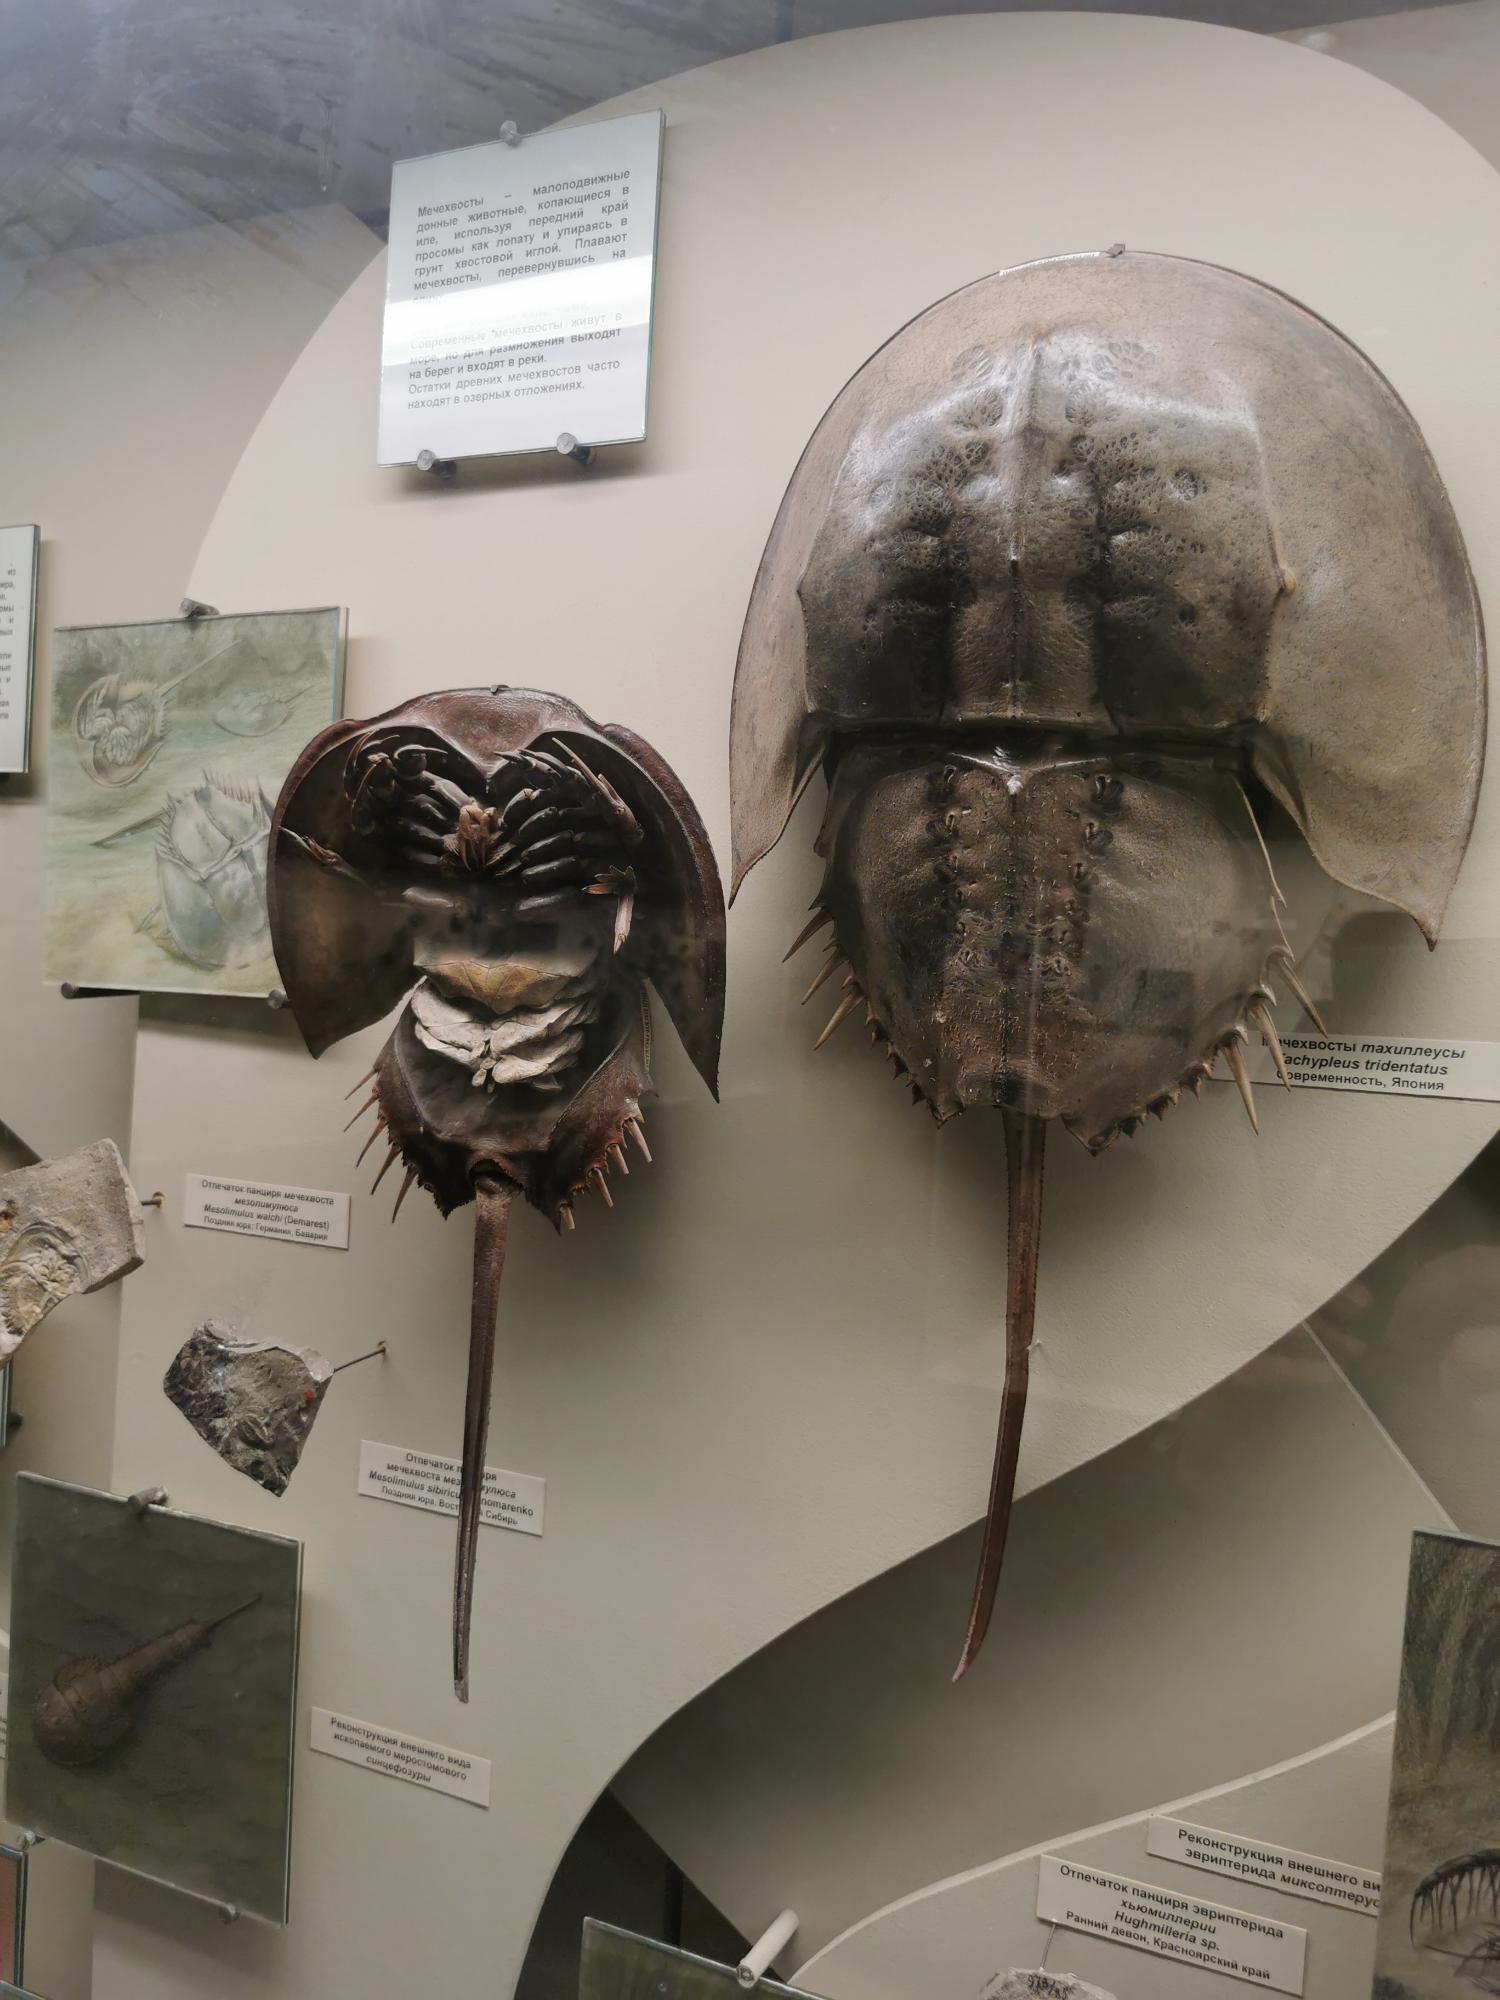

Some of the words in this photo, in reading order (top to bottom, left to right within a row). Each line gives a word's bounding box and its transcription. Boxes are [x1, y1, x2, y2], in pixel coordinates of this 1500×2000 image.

[418, 197, 484, 218] Мечехвосты
[533, 170, 631, 196] малоподвижные
[416, 217, 458, 234] донные
[468, 204, 527, 222] животные,
[538, 190, 611, 210] копающиеся
[623, 186, 629, 195] в
[416, 236, 439, 247] иле,
[454, 223, 512, 241] используя
[528, 209, 584, 227] передний
[601, 201, 629, 216] край
[415, 245, 465, 263] просомы
[471, 241, 489, 252] как
[496, 233, 535, 248] лопату
[543, 231, 550, 239] и
[557, 220, 612, 240] упираясь
[621, 217, 628, 226] в
[415, 264, 444, 277] грунт
[455, 251, 513, 271] хвостовой
[526, 244, 561, 258] иглой.
[575, 233, 628, 249] Плавают
[414, 272, 482, 291] мечехвосты,
[498, 256, 595, 279] перевернувшись
[612, 249, 626, 259] на
[489, 336, 564, 355] размножения
[571, 328, 622, 343] выходят
[409, 370, 422, 380] на
[425, 364, 453, 379] берег
[458, 366, 464, 374] и
[467, 360, 505, 374] входят
[508, 359, 514, 367] в
[518, 354, 547, 367] реки.
[409, 381, 451, 395] Остатки
[456, 375, 503, 391] древних
[508, 365, 581, 382] мечехвостов
[587, 360, 620, 371] часто
[408, 396, 451, 409] находят
[454, 395, 460, 403] в
[464, 389, 511, 405] озерных
[514, 380, 585, 397] отложениях.
[1281, 1053, 1360, 1070] achypleus
[1365, 1059, 1448, 1076] tridentatus
[1392, 1077, 1444, 1091] Япония
[202, 1180, 244, 1192] Отпечаток
[246, 1187, 282, 1199] панциря
[284, 1192, 334, 1205] мечехвоста
[204, 1204, 254, 1218] Mesolimulus
[257, 1213, 283, 1222] walchi
[284, 1216, 329, 1230] (Demarest)
[295, 1229, 328, 1240] Бавария
[387, 1463, 440, 1481] мечехвоста
[406, 1453, 454, 1472] Отпечаток
[369, 1470, 425, 1490] Mesolimulus
[485, 1509, 518, 1525] Сибирь
[331, 1717, 398, 1745] Реконструкция
[400, 1741, 445, 1760] внешнего
[448, 1756, 471, 1768] вида
[334, 1733, 392, 1756] ископаемого
[1178, 1828, 1284, 1867] Реконструкция
[1288, 1860, 1358, 1886] внешнего
[1185, 1849, 1277, 1880] эвриптерида
[1060, 1865, 1129, 1893] Отпечаток
[1132, 1887, 1189, 1911] панциря
[1192, 1904, 1284, 1939] эвриптерида
[1066, 1910, 1108, 1931] Ранний
[1111, 1925, 1150, 1945] девон,
[1153, 1938, 1239, 1971] Красноярский
[1241, 1963, 1270, 1980] край
[1114, 1910, 1196, 1944] Hughmilleria
[1200, 1937, 1220, 1951] sp.
